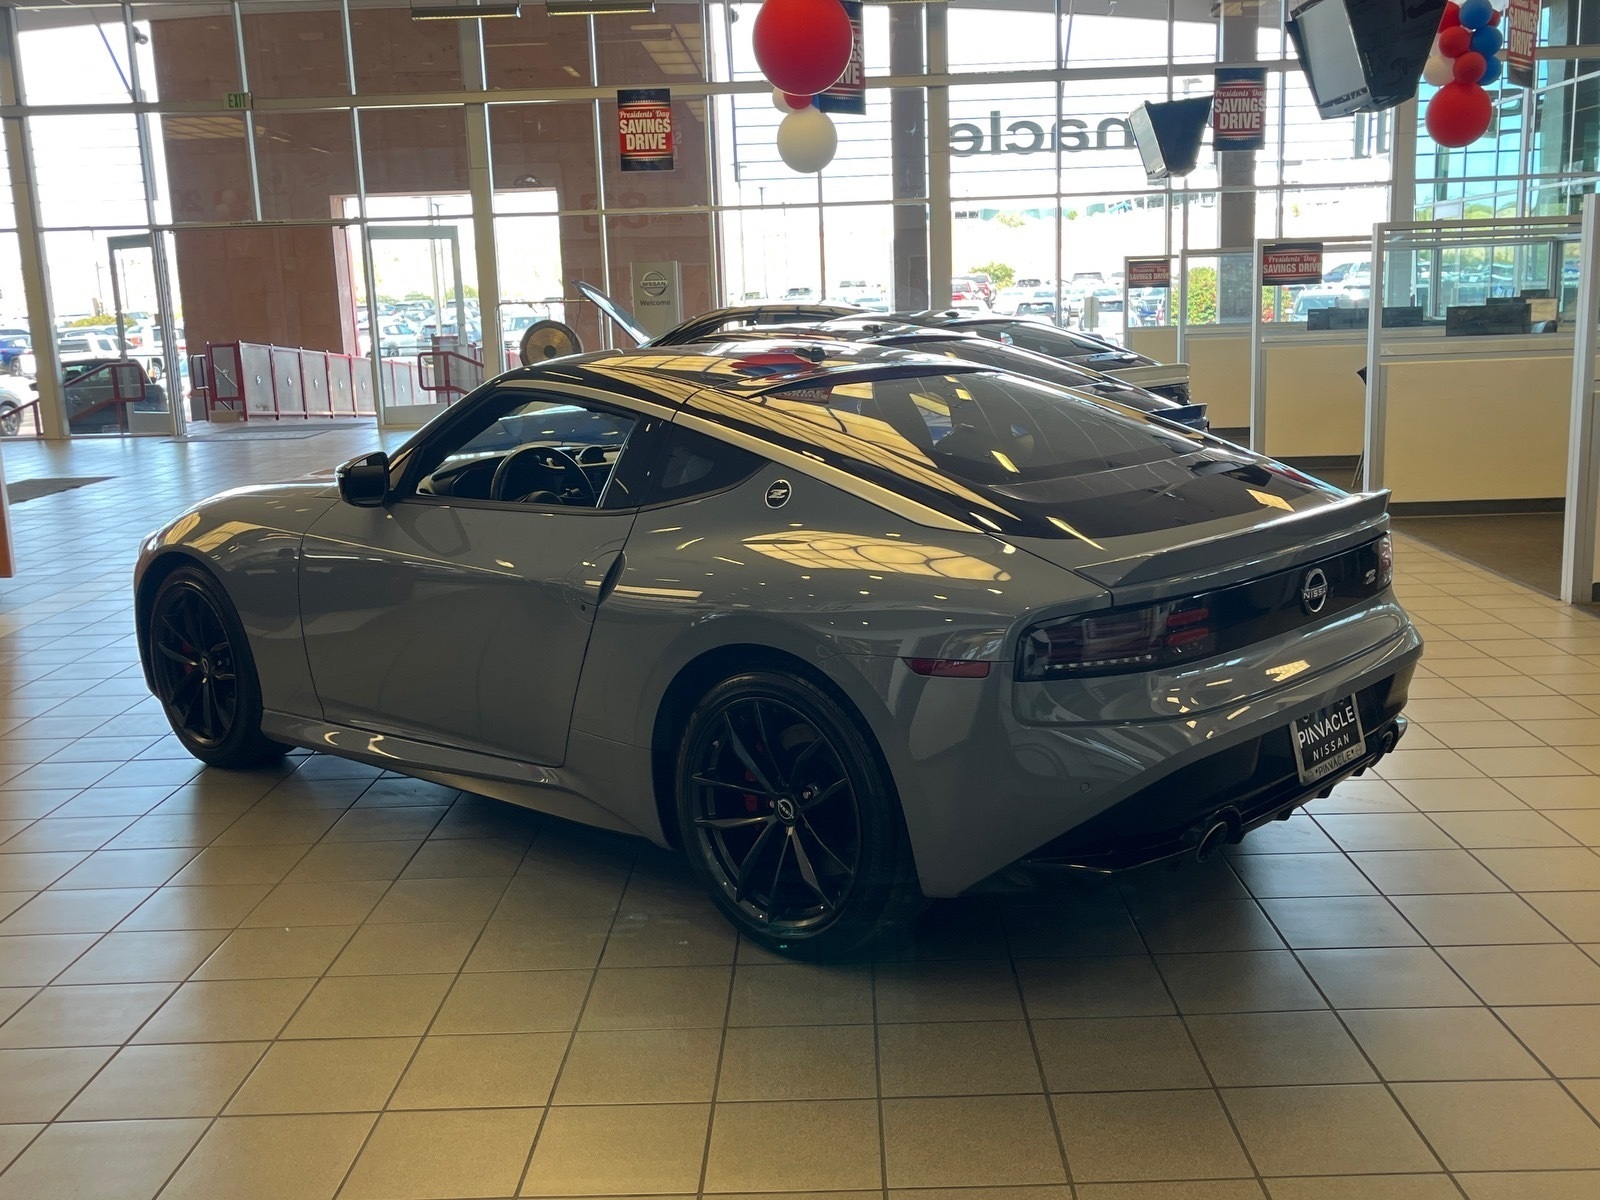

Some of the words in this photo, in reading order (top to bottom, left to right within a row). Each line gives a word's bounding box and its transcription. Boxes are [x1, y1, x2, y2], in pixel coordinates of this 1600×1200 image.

[1511, 28, 1533, 56] DRIVE
[227, 93, 246, 108] EXIT
[1214, 97, 1266, 113] SAVINGS
[619, 110, 655, 118] Presidents'
[655, 109, 670, 119] Day
[1220, 112, 1260, 129] DRIVE
[619, 118, 671, 134] SAVINGS
[625, 133, 667, 150] DRIVE
[1263, 263, 1297, 274] SAVINGS
[1298, 262, 1322, 273] DRIVE
[1312, 733, 1350, 762] NISSAN
